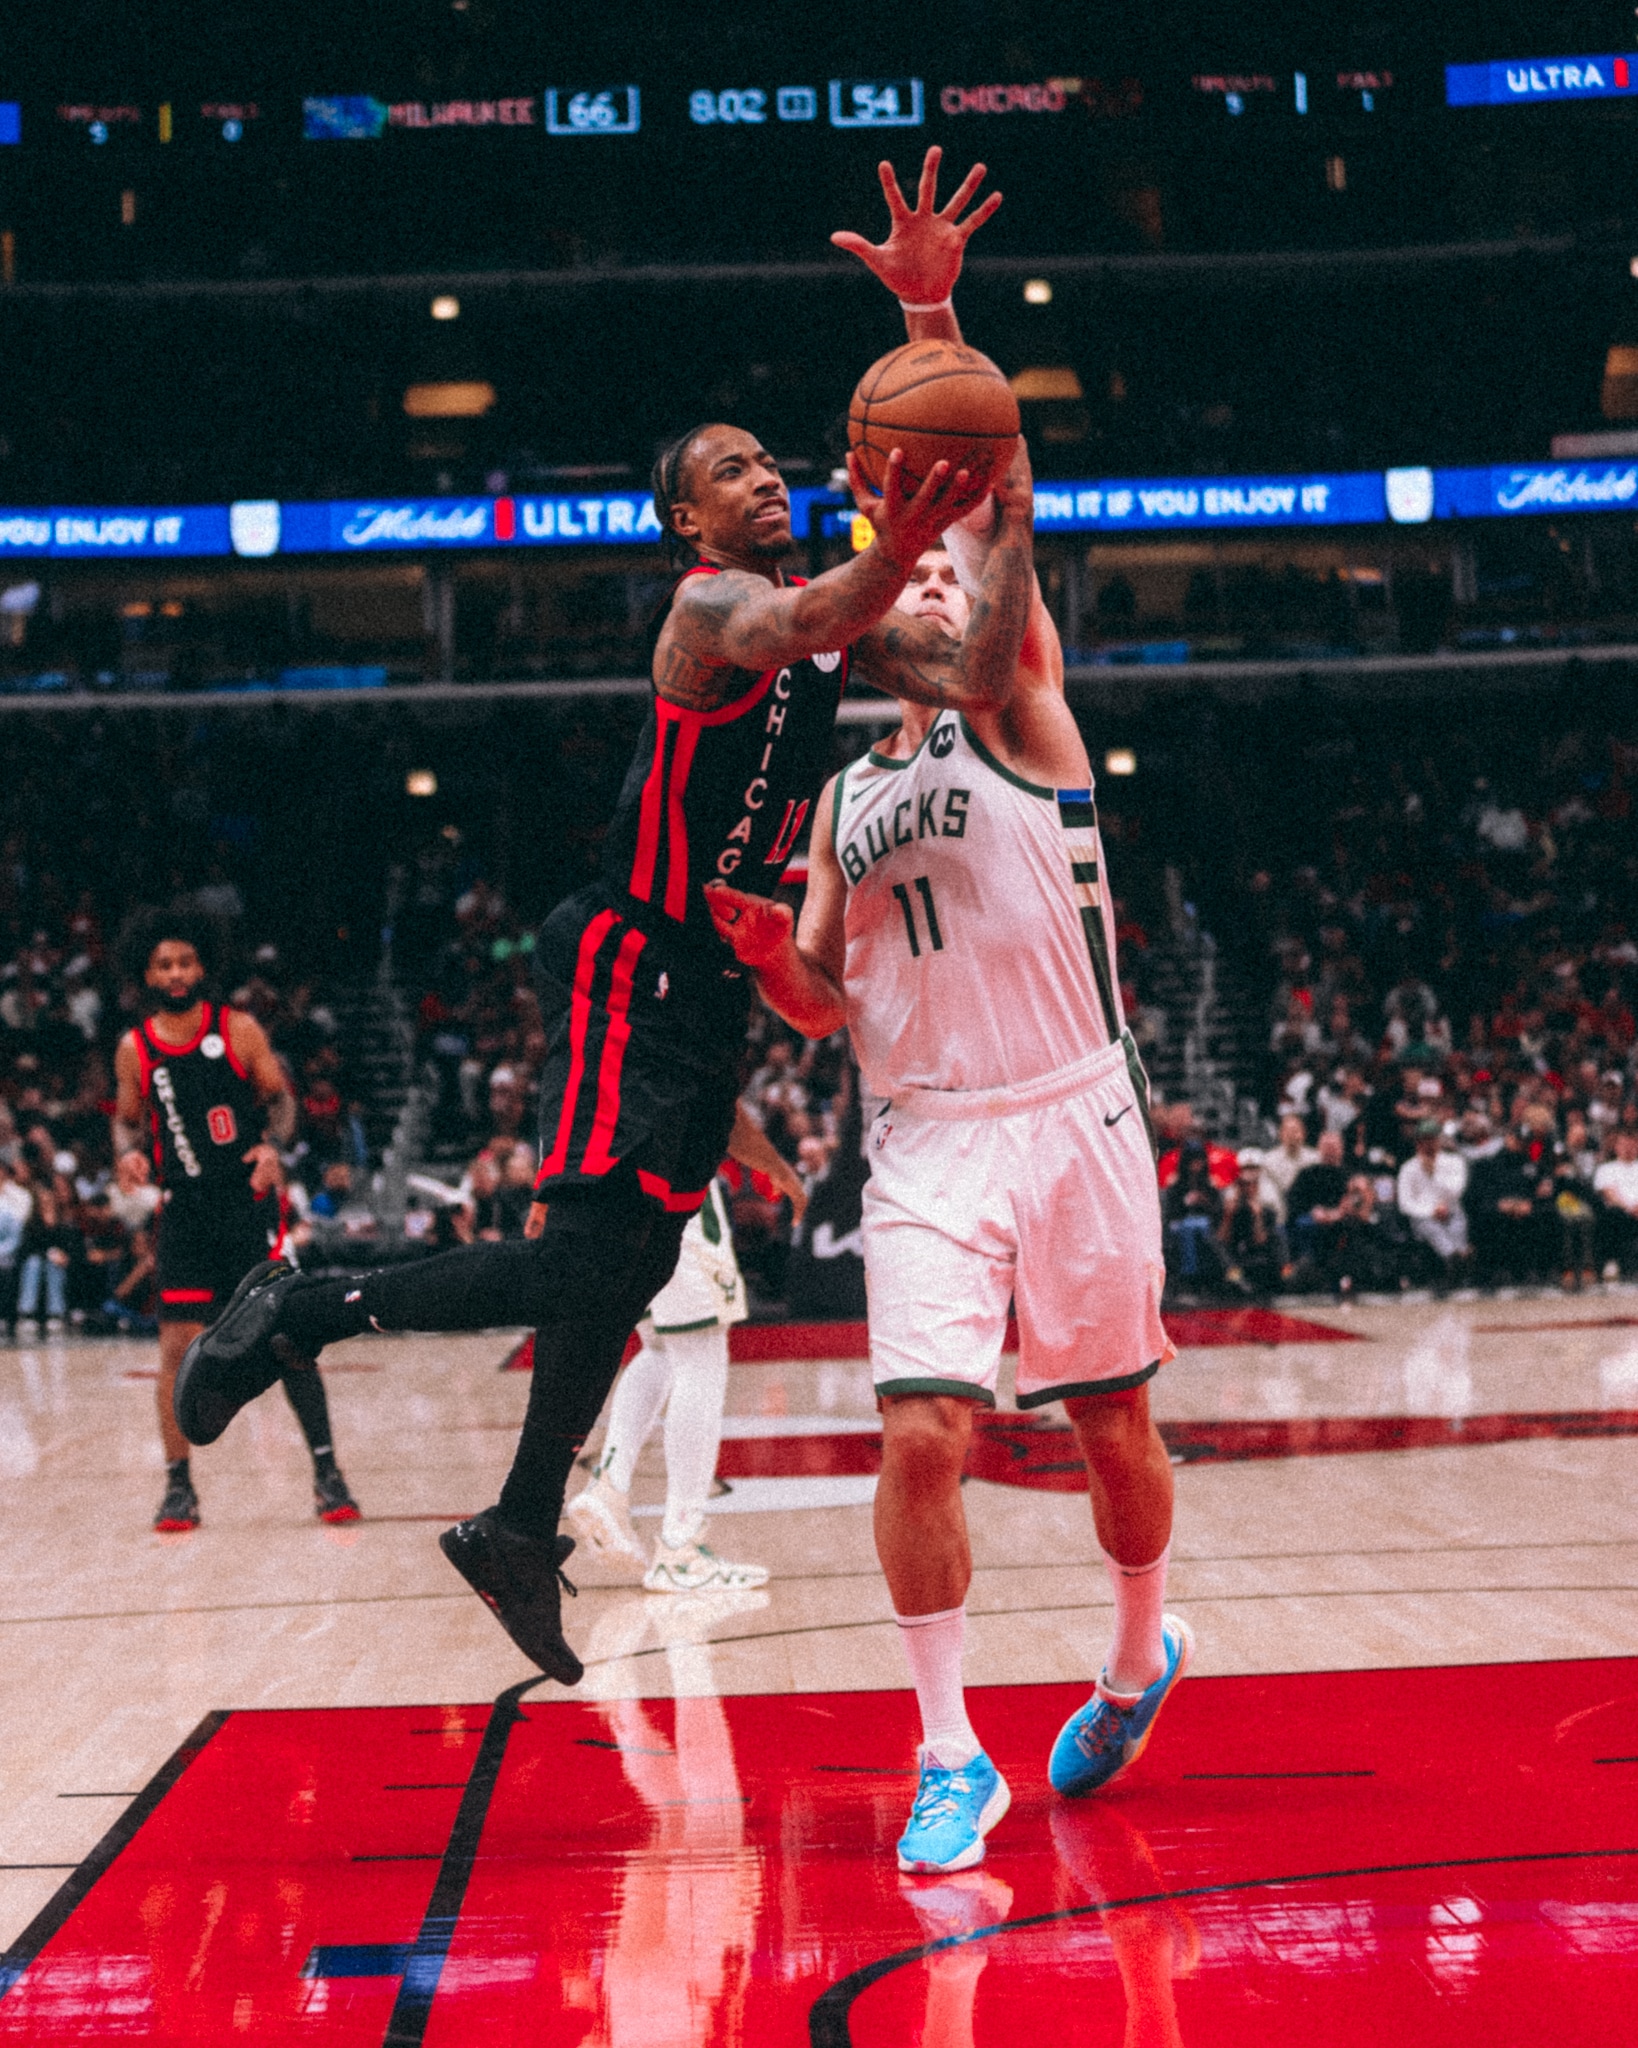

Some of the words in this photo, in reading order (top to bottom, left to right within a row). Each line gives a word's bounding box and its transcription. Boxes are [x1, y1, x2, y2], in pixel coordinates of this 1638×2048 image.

[1506, 63, 1606, 93] ULTRA
[568, 92, 617, 127] 66
[853, 84, 899, 120] 54
[521, 499, 663, 537] ULTRA
[1138, 487, 1199, 517] YOU
[1203, 485, 1296, 516] ENJOY
[1301, 483, 1330, 513] IT
[54, 516, 149, 546] ENJOY
[153, 515, 184, 545] IT
[709, 667, 792, 886] CHICAG
[840, 787, 971, 887] BUCKS
[891, 875, 944, 958] 11
[152, 1066, 202, 1178] CHICAGO
[206, 1104, 238, 1146] 0
